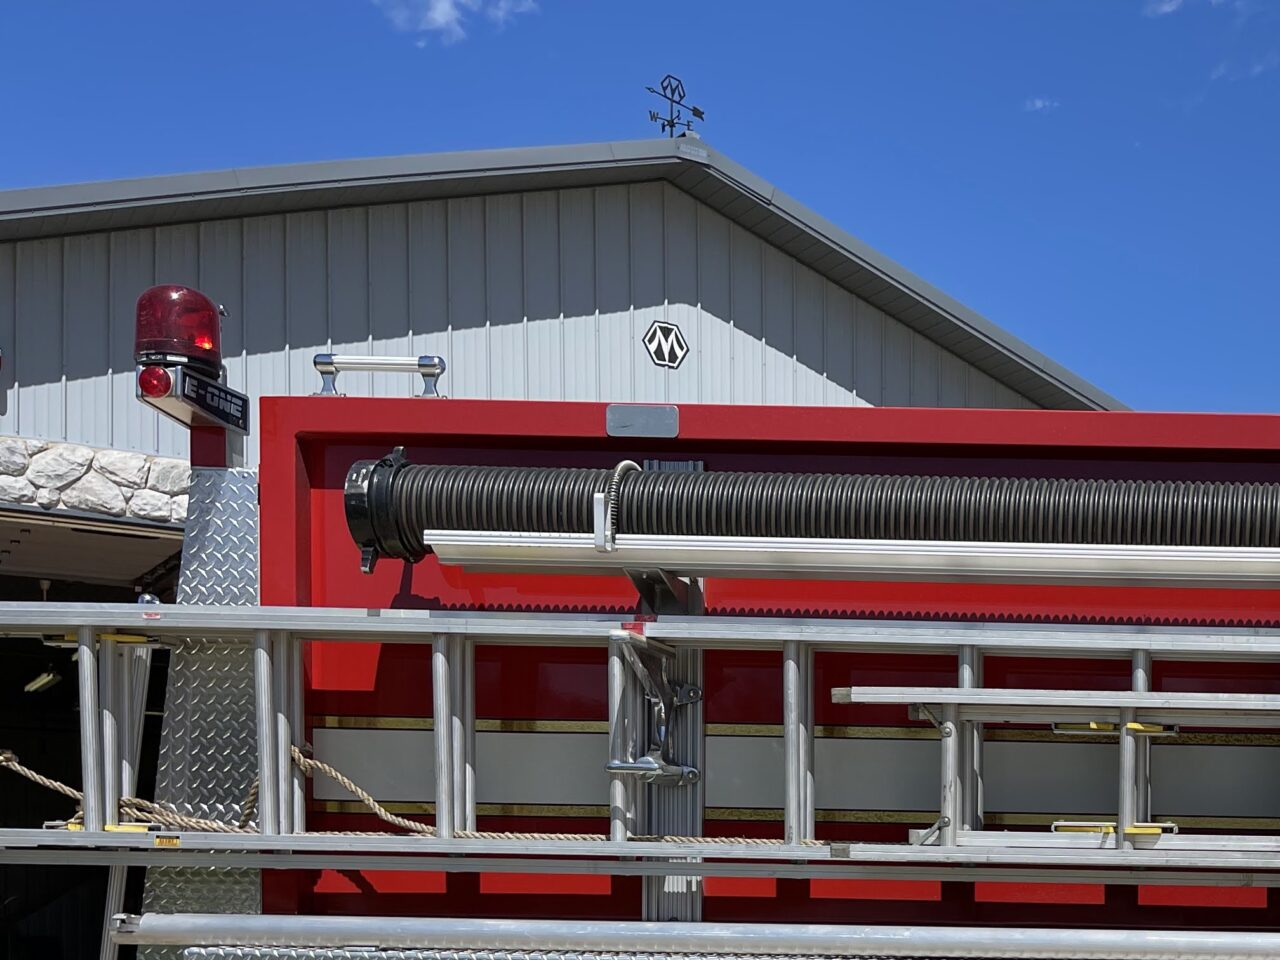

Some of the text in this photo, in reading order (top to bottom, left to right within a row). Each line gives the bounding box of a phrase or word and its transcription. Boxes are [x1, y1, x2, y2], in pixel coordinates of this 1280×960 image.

[648, 110, 659, 123] W
[646, 323, 685, 365] M
[185, 376, 243, 418] E-ONE
